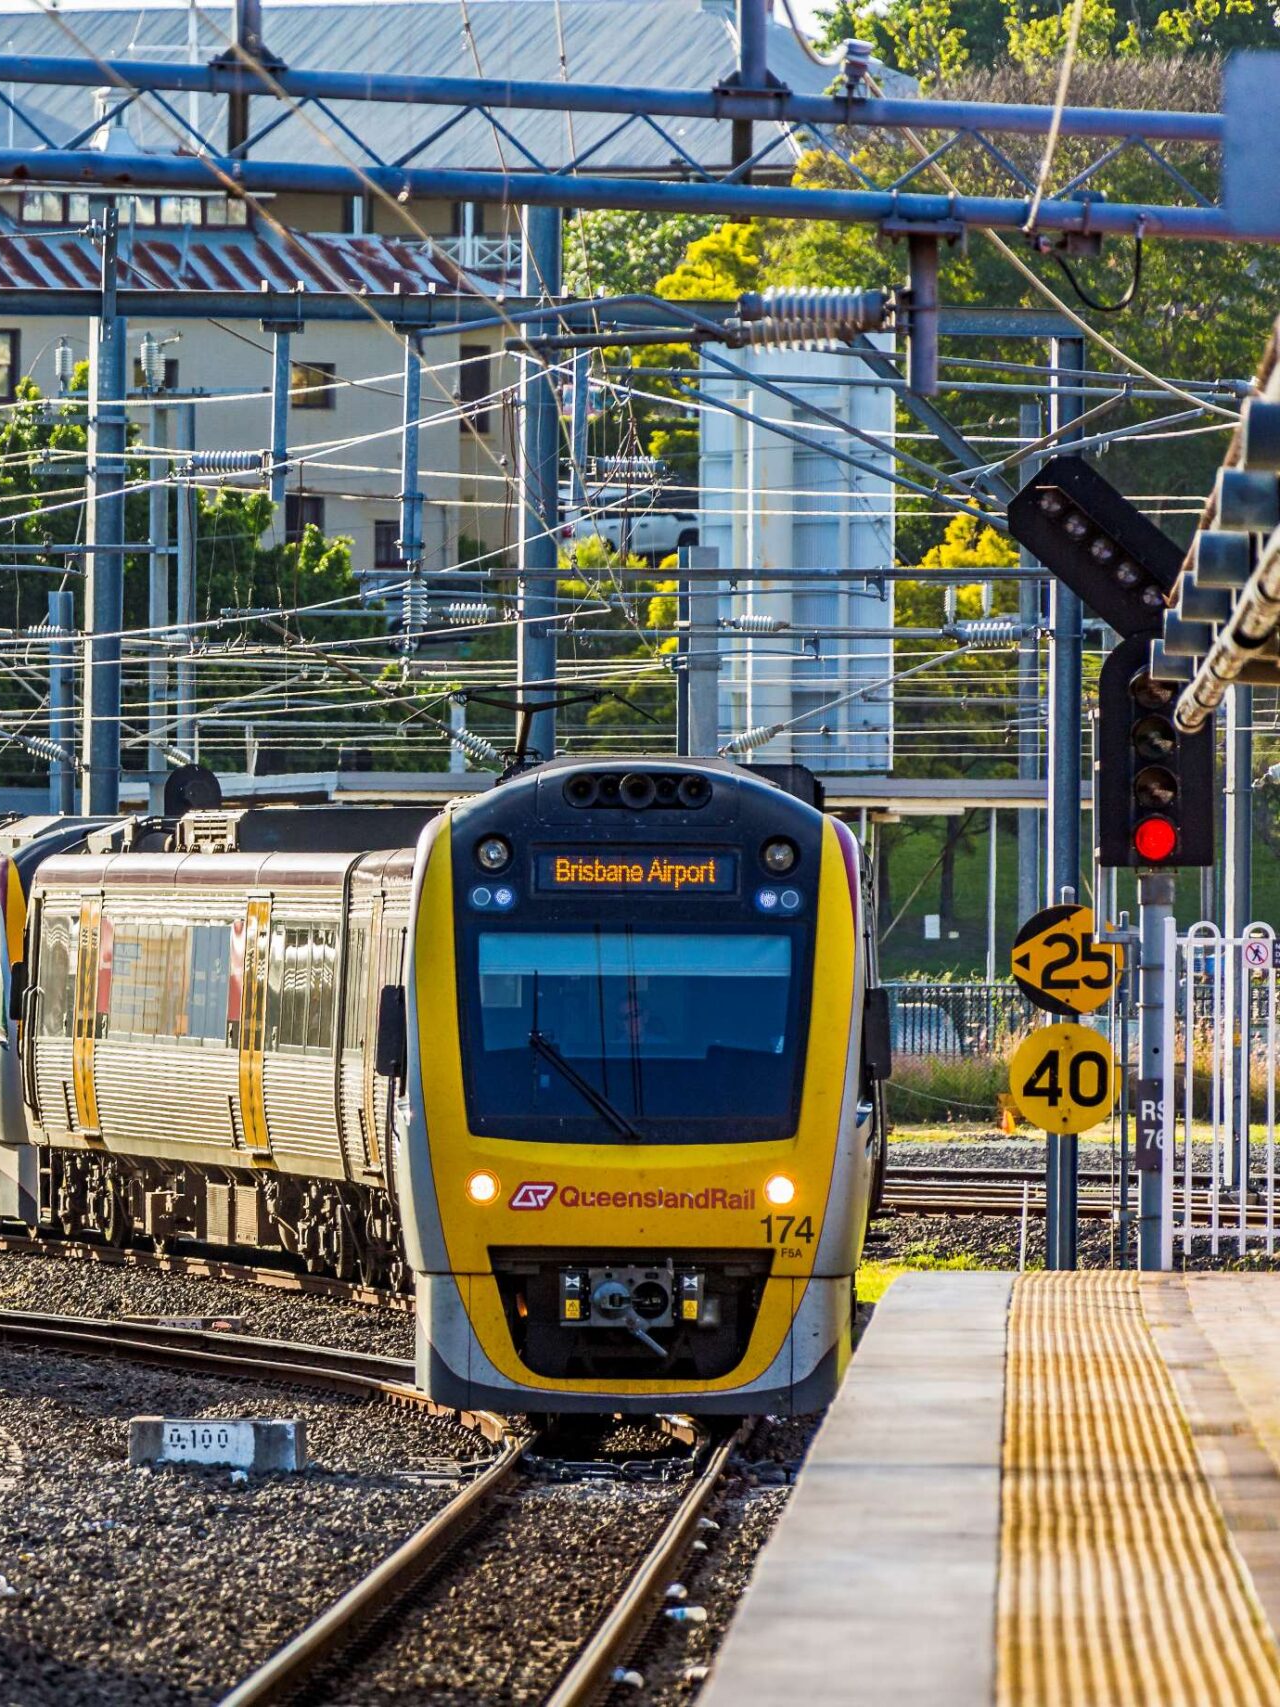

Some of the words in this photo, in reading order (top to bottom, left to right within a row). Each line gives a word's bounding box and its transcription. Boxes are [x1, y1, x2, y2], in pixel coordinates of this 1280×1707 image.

[555, 857, 644, 882] Brisbane
[647, 857, 716, 890] Airport
[1041, 932, 1116, 989] 25
[1023, 1050, 1108, 1107] 40
[559, 1186, 755, 1210] QueenslandRail
[760, 1214, 815, 1244] 174
[781, 1248, 803, 1258] F5A
[170, 1428, 228, 1450] 0.100
